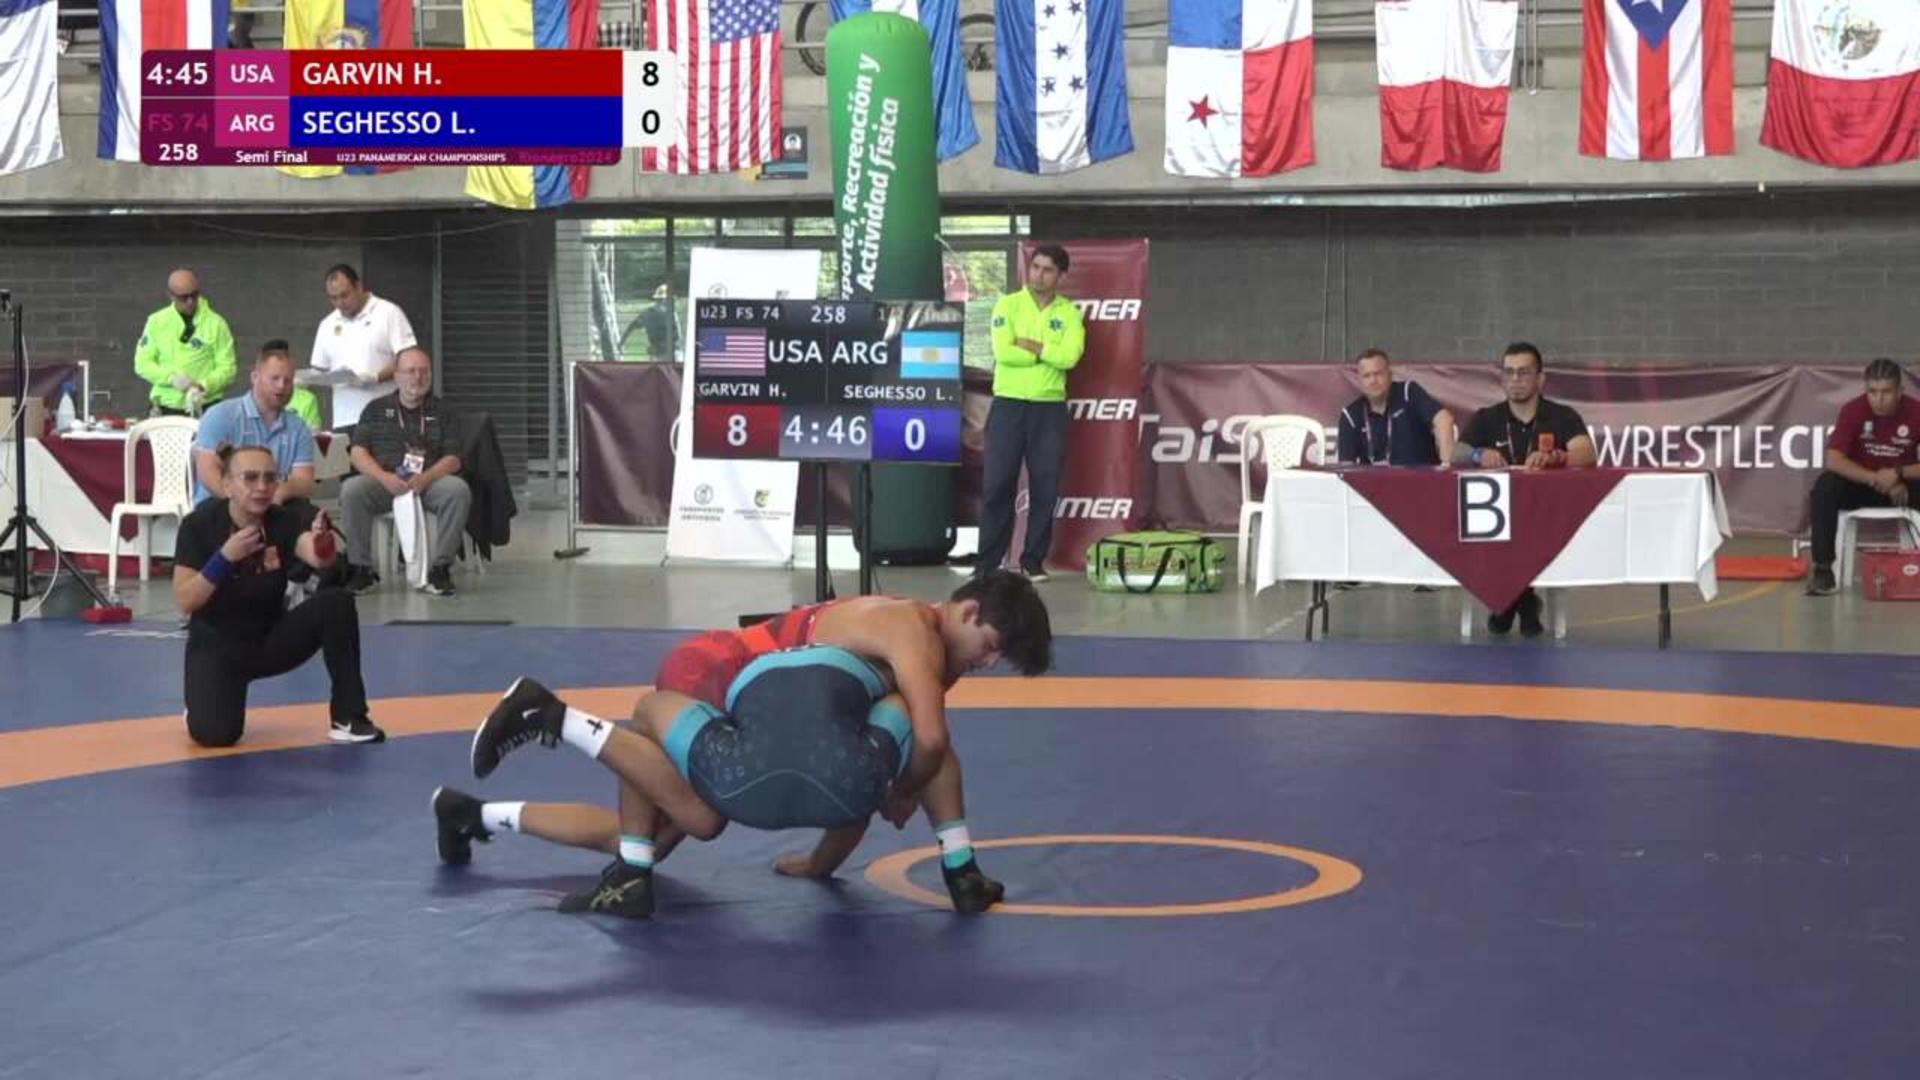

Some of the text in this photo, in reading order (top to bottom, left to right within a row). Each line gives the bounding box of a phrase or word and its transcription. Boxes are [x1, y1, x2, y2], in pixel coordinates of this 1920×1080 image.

[841, 53, 881, 301] porte, Recreación y
[856, 169, 890, 293] Actividad
[700, 305, 779, 320] U23 FS 74
[811, 306, 846, 324] 258
[1072, 299, 1142, 320] MER
[768, 340, 823, 364] USA
[832, 340, 889, 365] ARG
[699, 382, 787, 397] GARVIN H.
[844, 384, 953, 400] SEGHESSO L.
[1066, 399, 1138, 420] MER
[727, 414, 747, 446] 8
[784, 415, 867, 445] 4:46
[904, 418, 925, 450] 0
[1055, 497, 1133, 519] MER
[1460, 475, 1506, 539] B
